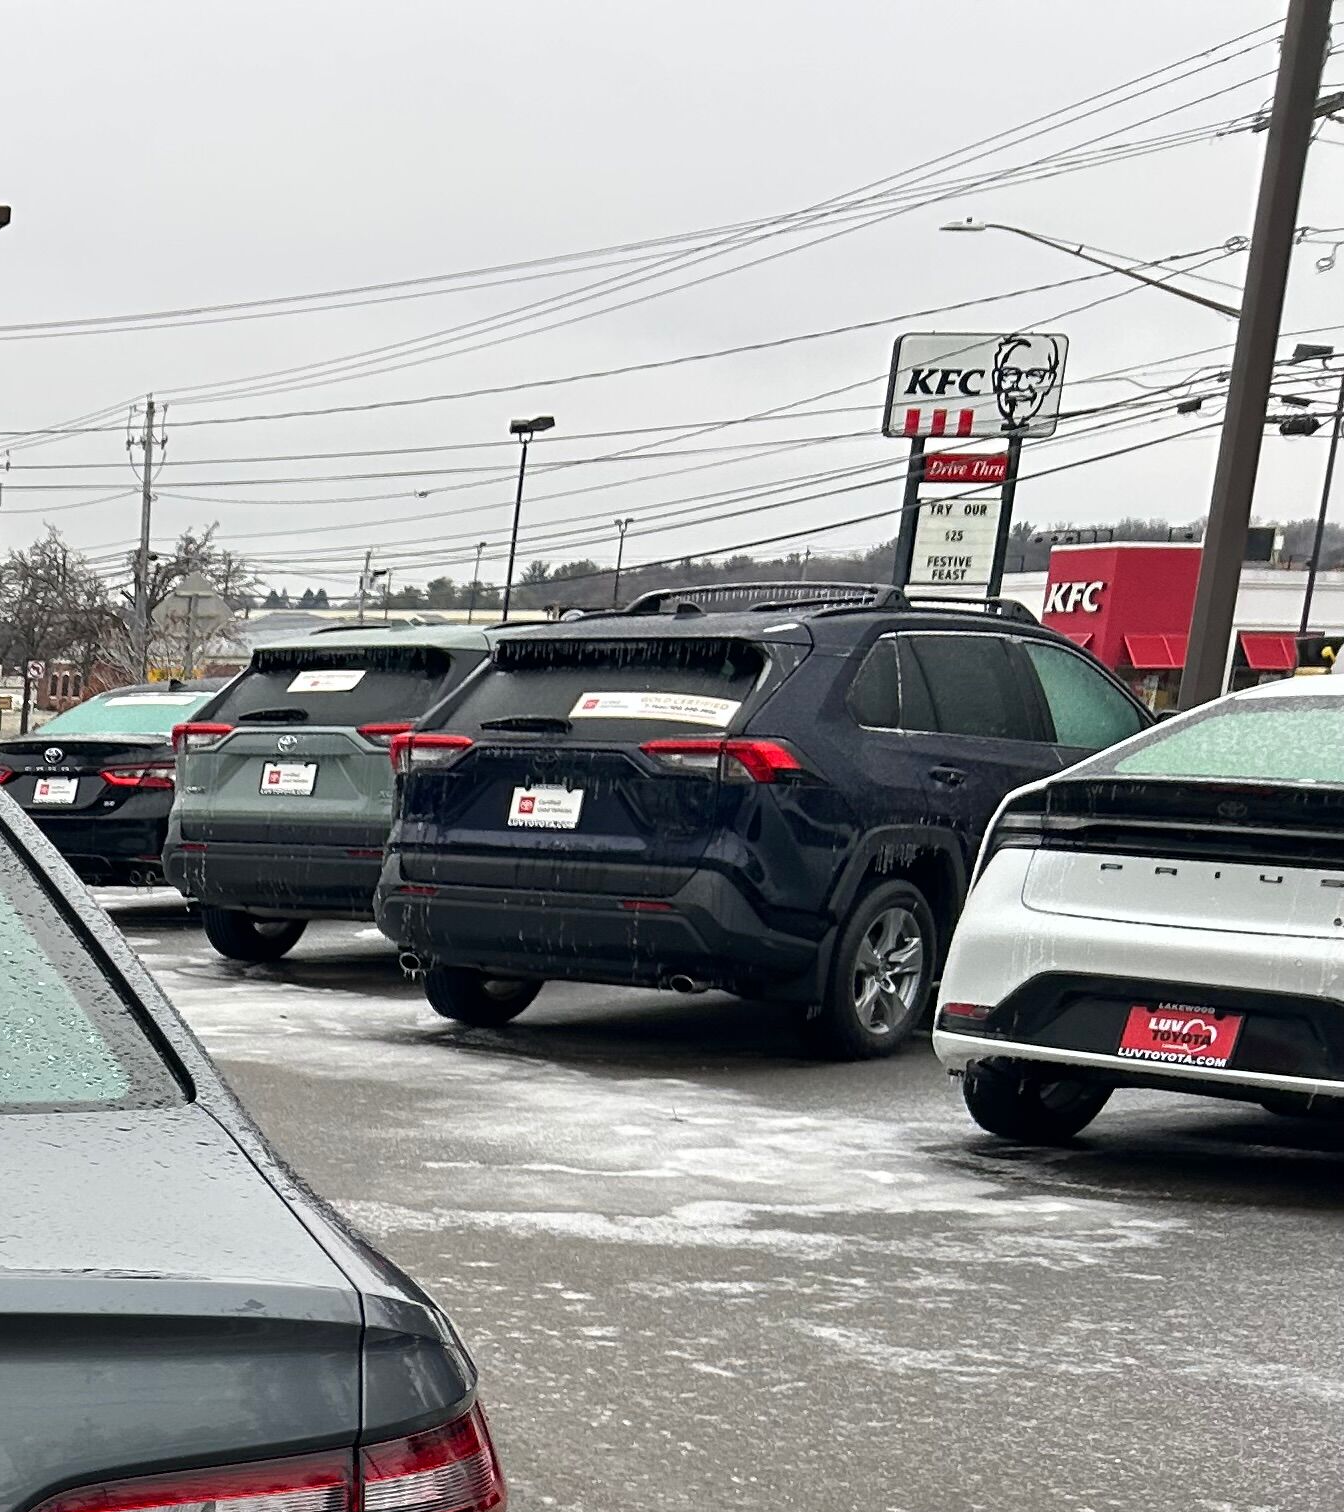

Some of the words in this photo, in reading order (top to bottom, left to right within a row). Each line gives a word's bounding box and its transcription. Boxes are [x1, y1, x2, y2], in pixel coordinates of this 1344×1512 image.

[904, 368, 985, 395] KFC
[929, 461, 967, 476] Drive
[972, 459, 1005, 476] Thru
[930, 503, 953, 516] TRY
[963, 503, 987, 516] OUR
[927, 555, 973, 567] FESTIVE
[932, 569, 967, 581] FEAST
[1044, 581, 1104, 613] KFC
[1100, 863, 1344, 888] PRIUS
[1158, 1002, 1216, 1015] LAKEWOOD
[1148, 1017, 1184, 1032] LUV
[1152, 1029, 1212, 1046] TOYOTA
[1117, 1047, 1227, 1068] LUVTOYOTA.COM
